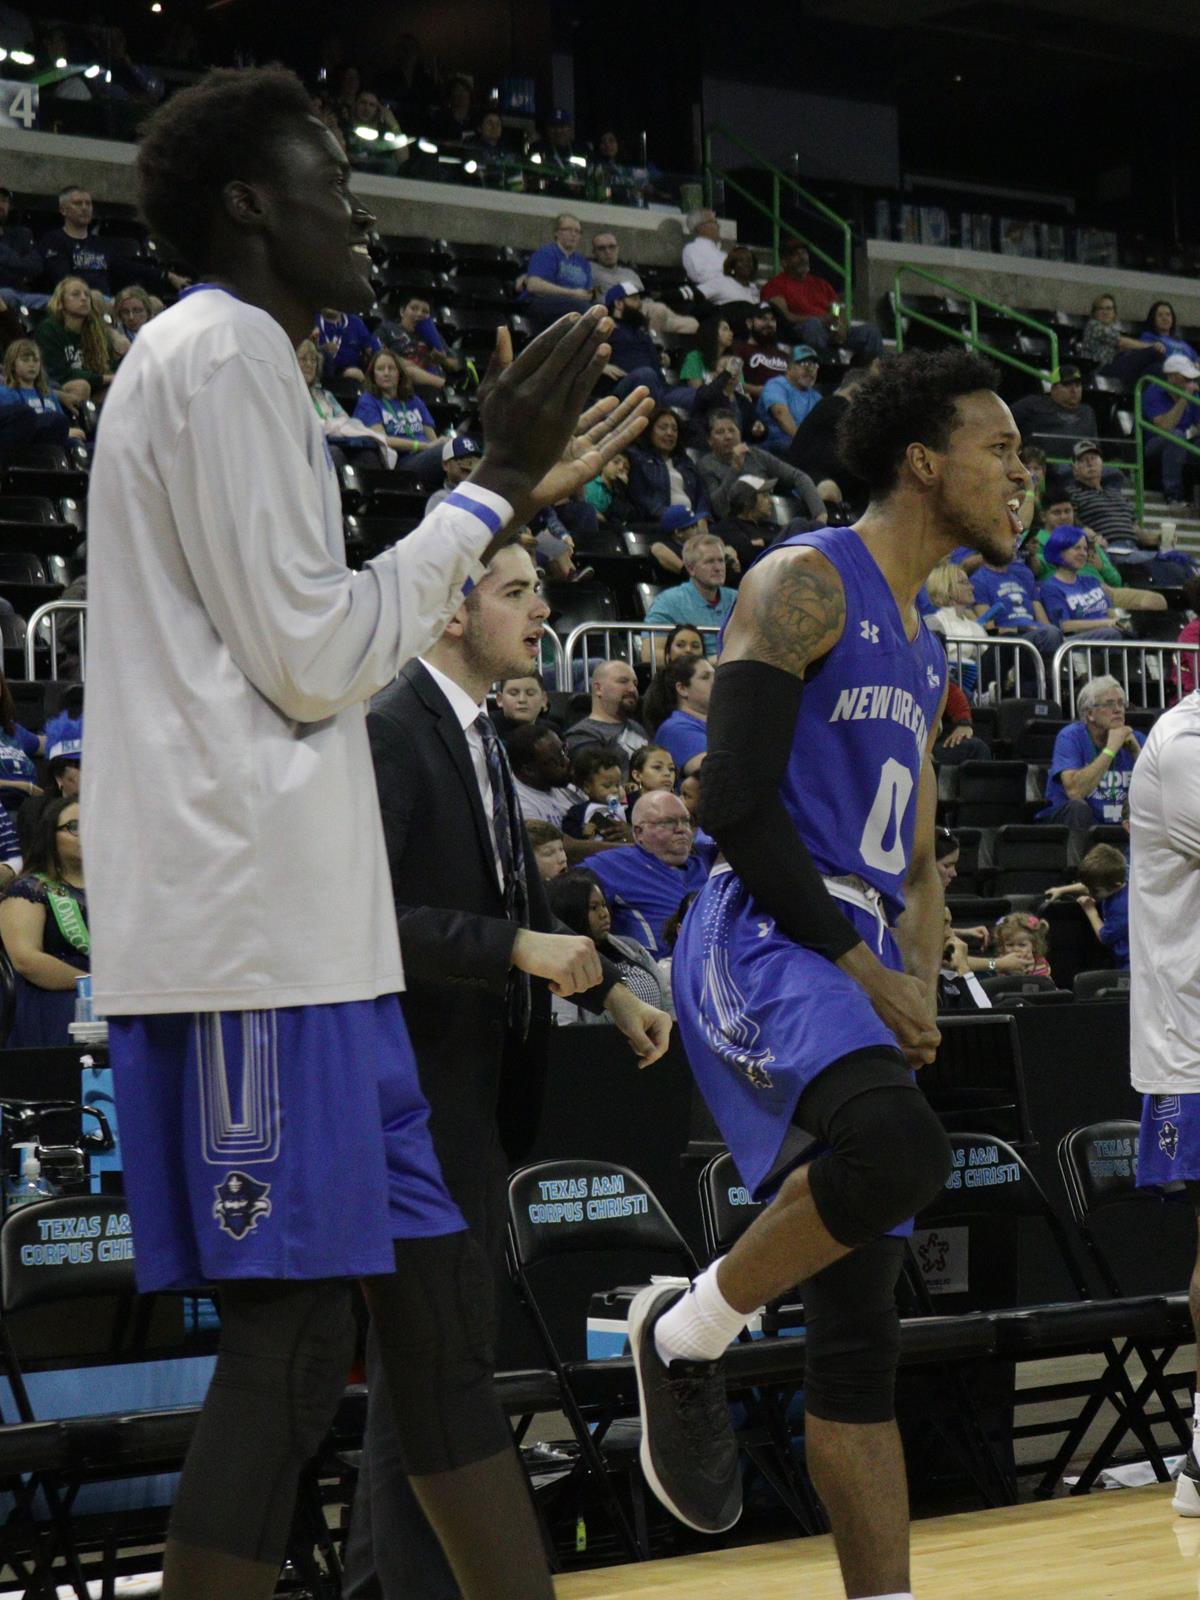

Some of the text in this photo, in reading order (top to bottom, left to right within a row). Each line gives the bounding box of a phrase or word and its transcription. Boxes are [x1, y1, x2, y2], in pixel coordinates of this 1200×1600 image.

[828, 685, 894, 722] NEW
[859, 757, 914, 876] 0
[968, 1145, 998, 1166] A&M
[1093, 1138, 1132, 1157] TEXAS
[538, 1174, 625, 1201] TEXAS A&M
[965, 1163, 1021, 1188] CHRISTI
[529, 1194, 649, 1224] CORPUS CHRISTI
[38, 1214, 133, 1240] TEXAS A&
[21, 1242, 94, 1266] CORPUS
